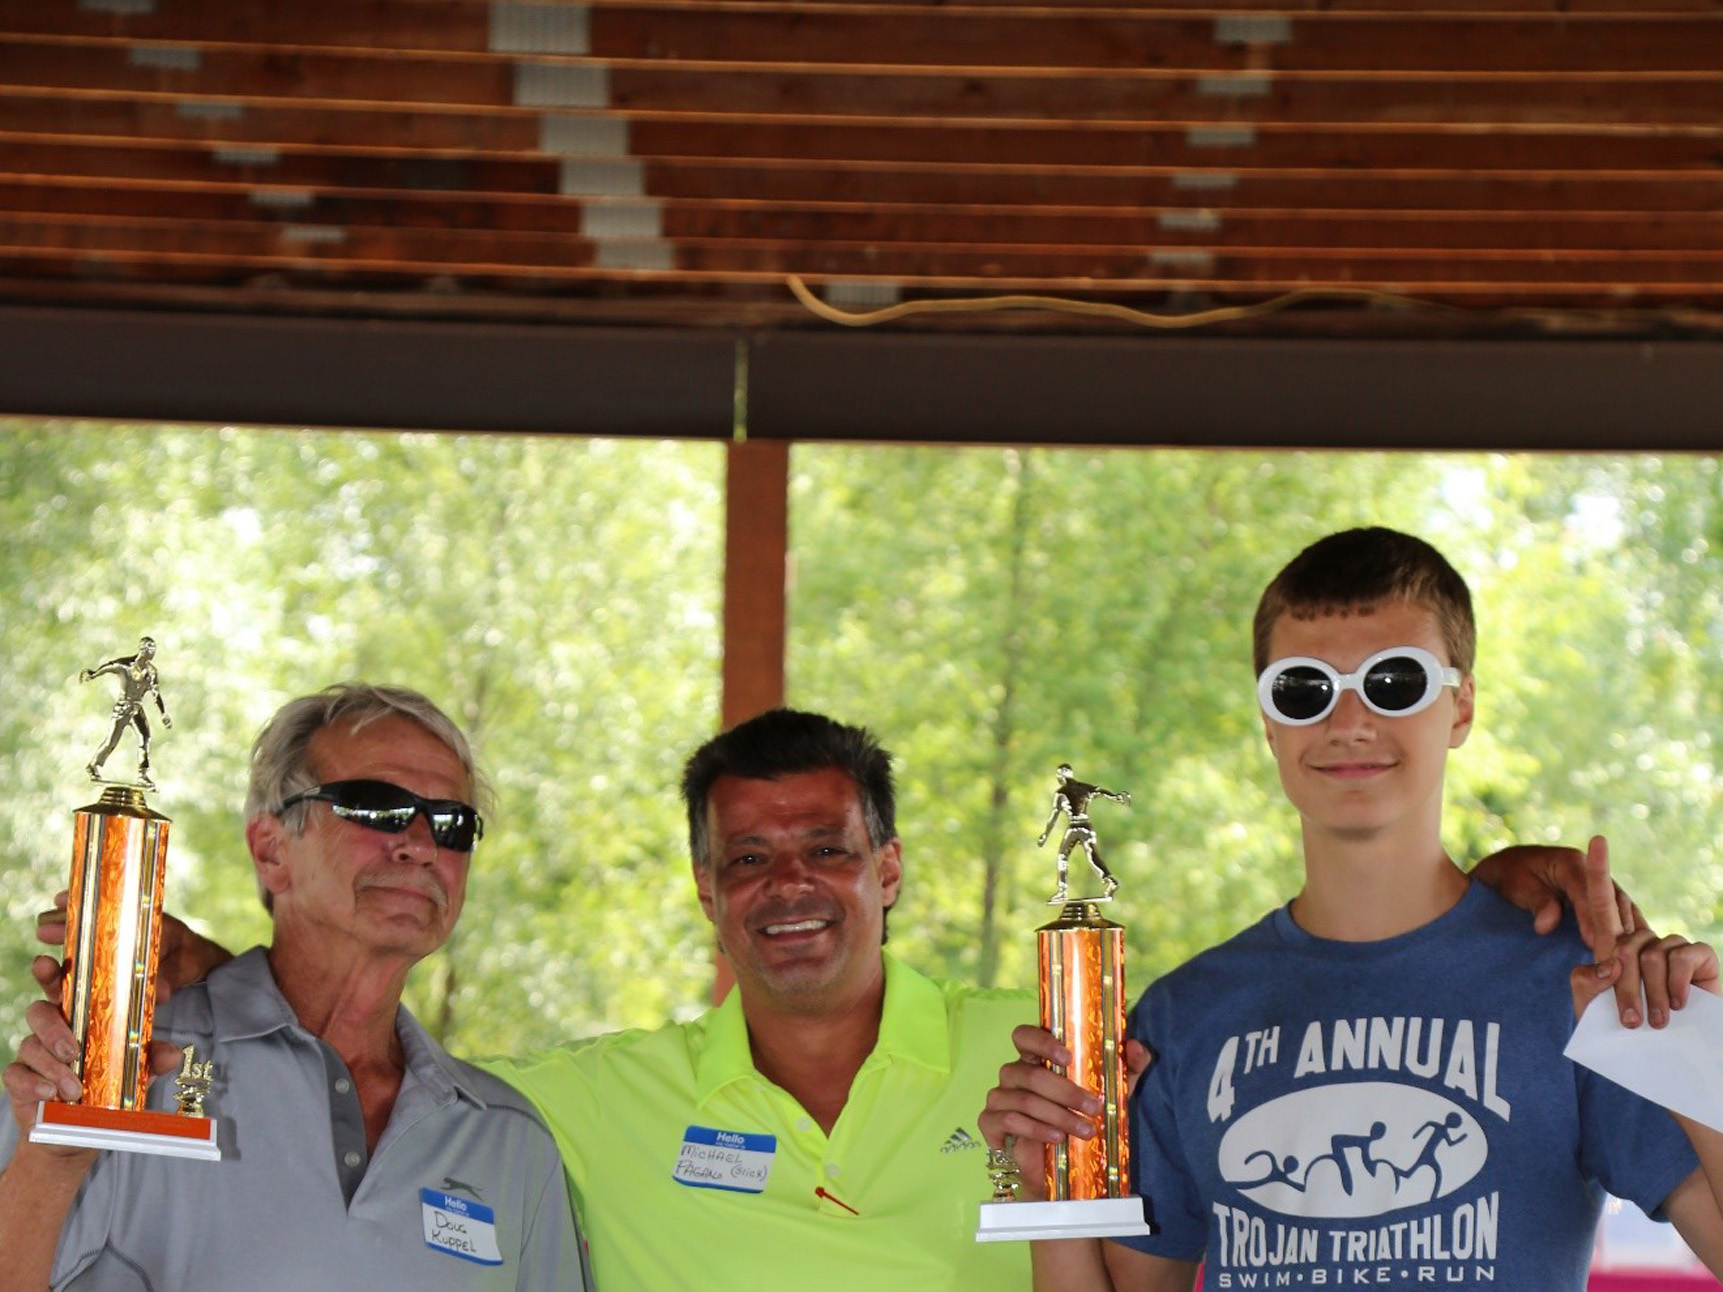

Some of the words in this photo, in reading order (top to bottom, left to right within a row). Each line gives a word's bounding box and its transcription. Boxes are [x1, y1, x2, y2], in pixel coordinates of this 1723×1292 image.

[179, 1044, 213, 1080] 1st
[1293, 1016, 1511, 1122] ANNUAL
[716, 1131, 745, 1145] Hello
[444, 1196, 467, 1212] Hello
[1212, 1201, 1319, 1268] TROJAN
[1329, 1191, 1499, 1262] TRIATHLON
[1219, 1271, 1291, 1288] SWIM
[1311, 1266, 1391, 1285] BIKE
[1418, 1265, 1496, 1282] RUN
